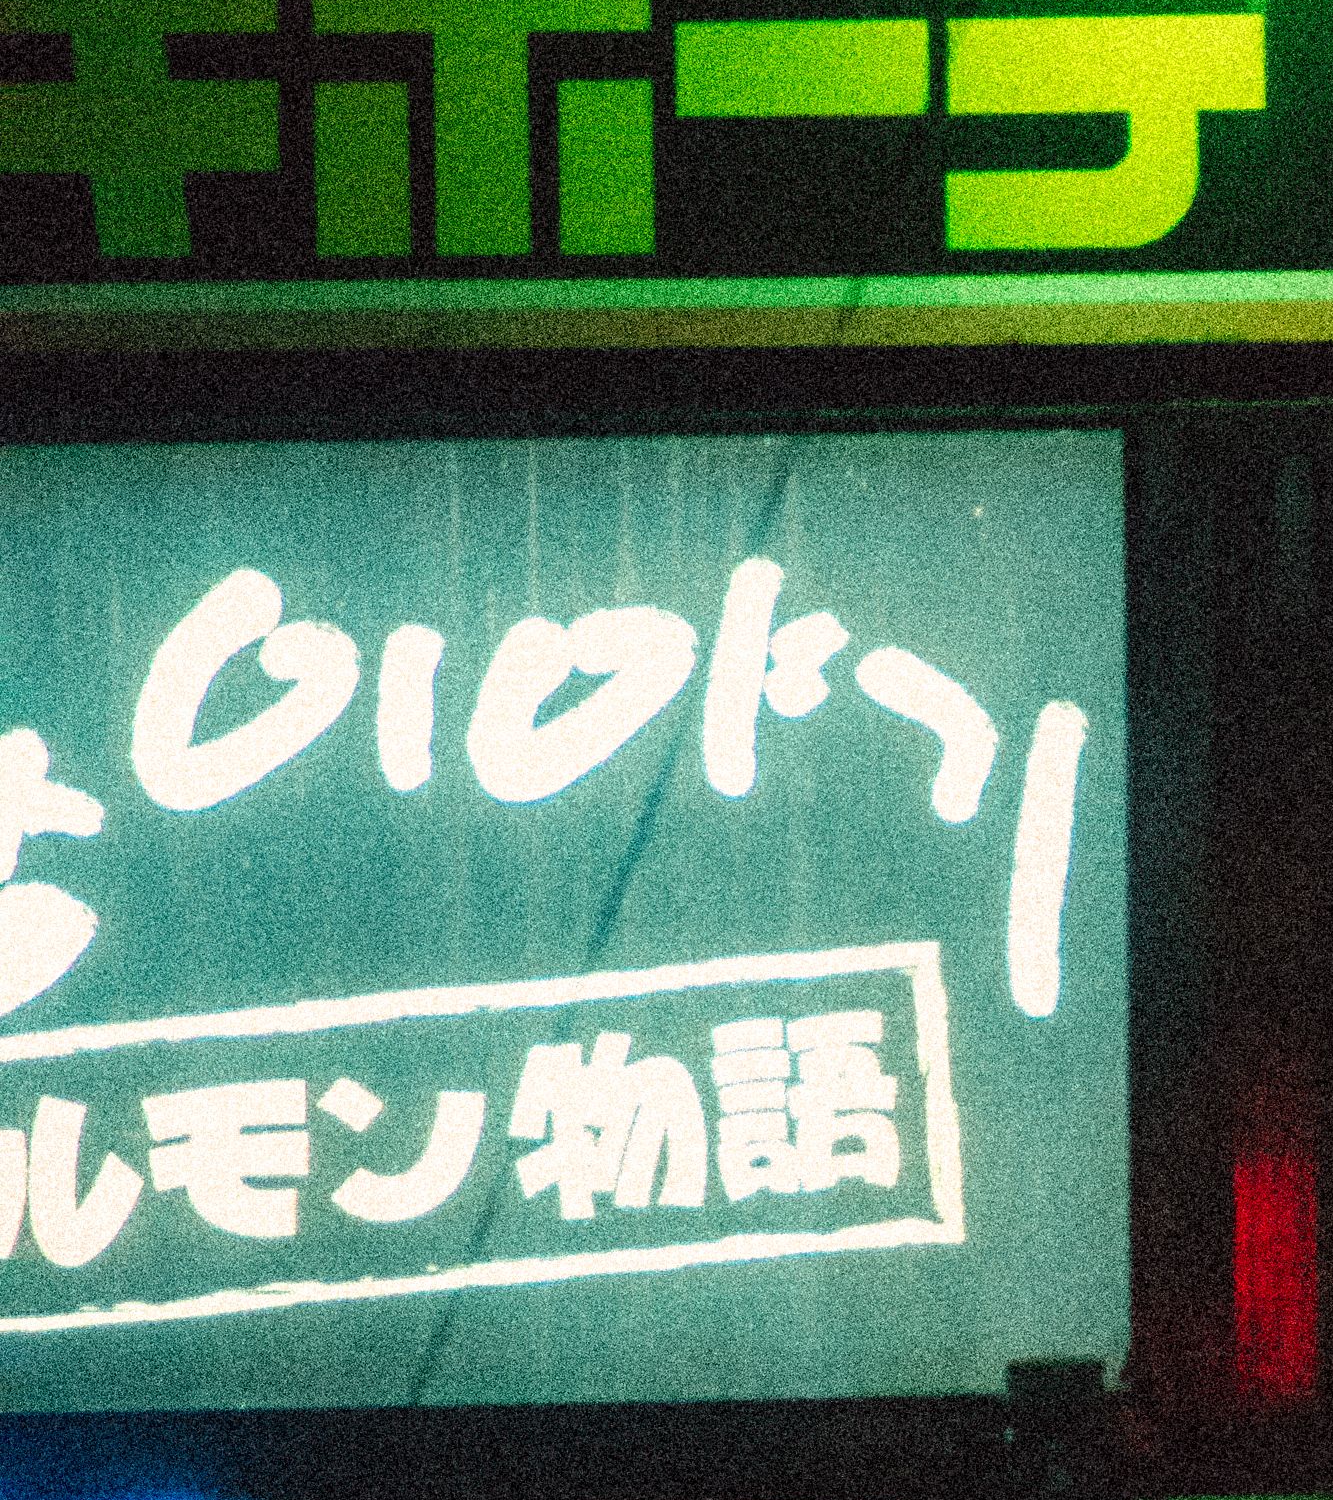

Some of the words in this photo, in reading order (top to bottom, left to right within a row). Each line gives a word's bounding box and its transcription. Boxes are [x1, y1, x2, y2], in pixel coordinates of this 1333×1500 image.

[0, 1009, 902, 1268] ルモン物語
